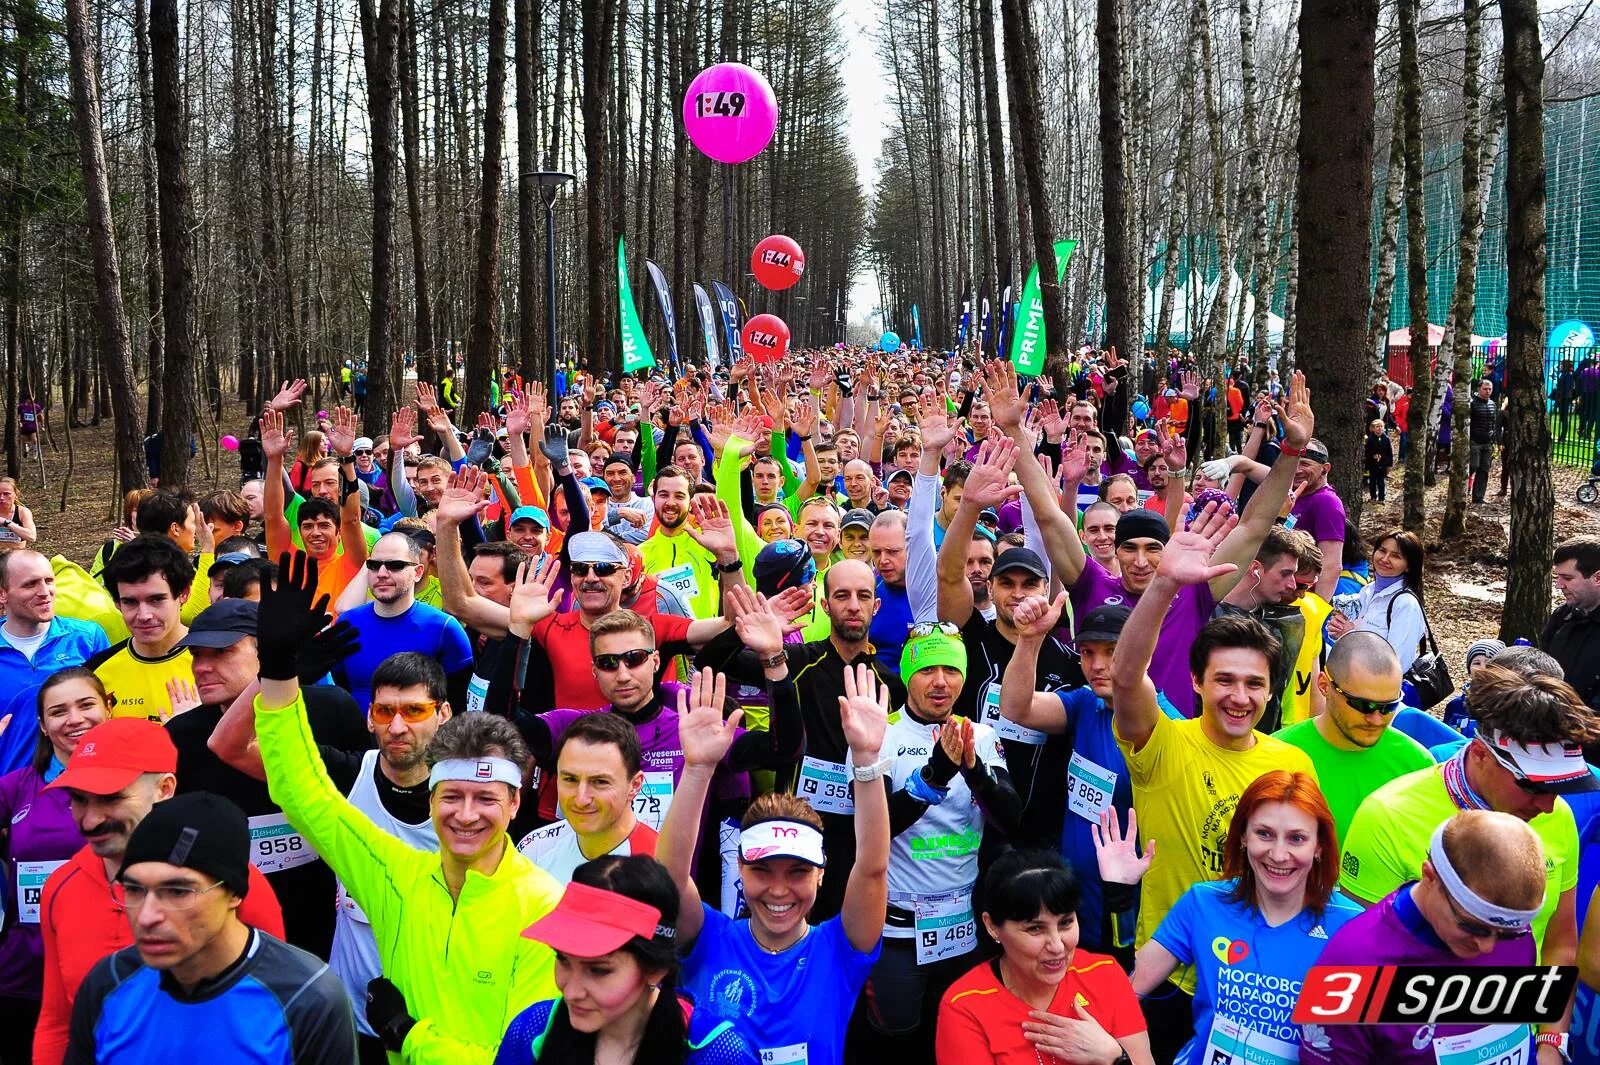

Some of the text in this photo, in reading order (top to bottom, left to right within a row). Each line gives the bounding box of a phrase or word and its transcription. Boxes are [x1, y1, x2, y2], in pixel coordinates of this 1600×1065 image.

[1018, 297, 1043, 366] PRIME
[121, 698, 144, 706] MSIG
[907, 747, 927, 756] asics
[650, 758, 674, 767] grom
[1079, 783, 1103, 807] 862
[251, 827, 286, 840] Денис
[771, 826, 798, 838] TYR
[259, 836, 303, 856] 958
[938, 913, 969, 927] Michael
[944, 921, 974, 941] 468
[1218, 966, 1304, 995] МОСКОВС
[1217, 997, 1291, 1024] MOSCOW
[1245, 1047, 1277, 1065] Нина
[1477, 1039, 1508, 1060] Юрий
